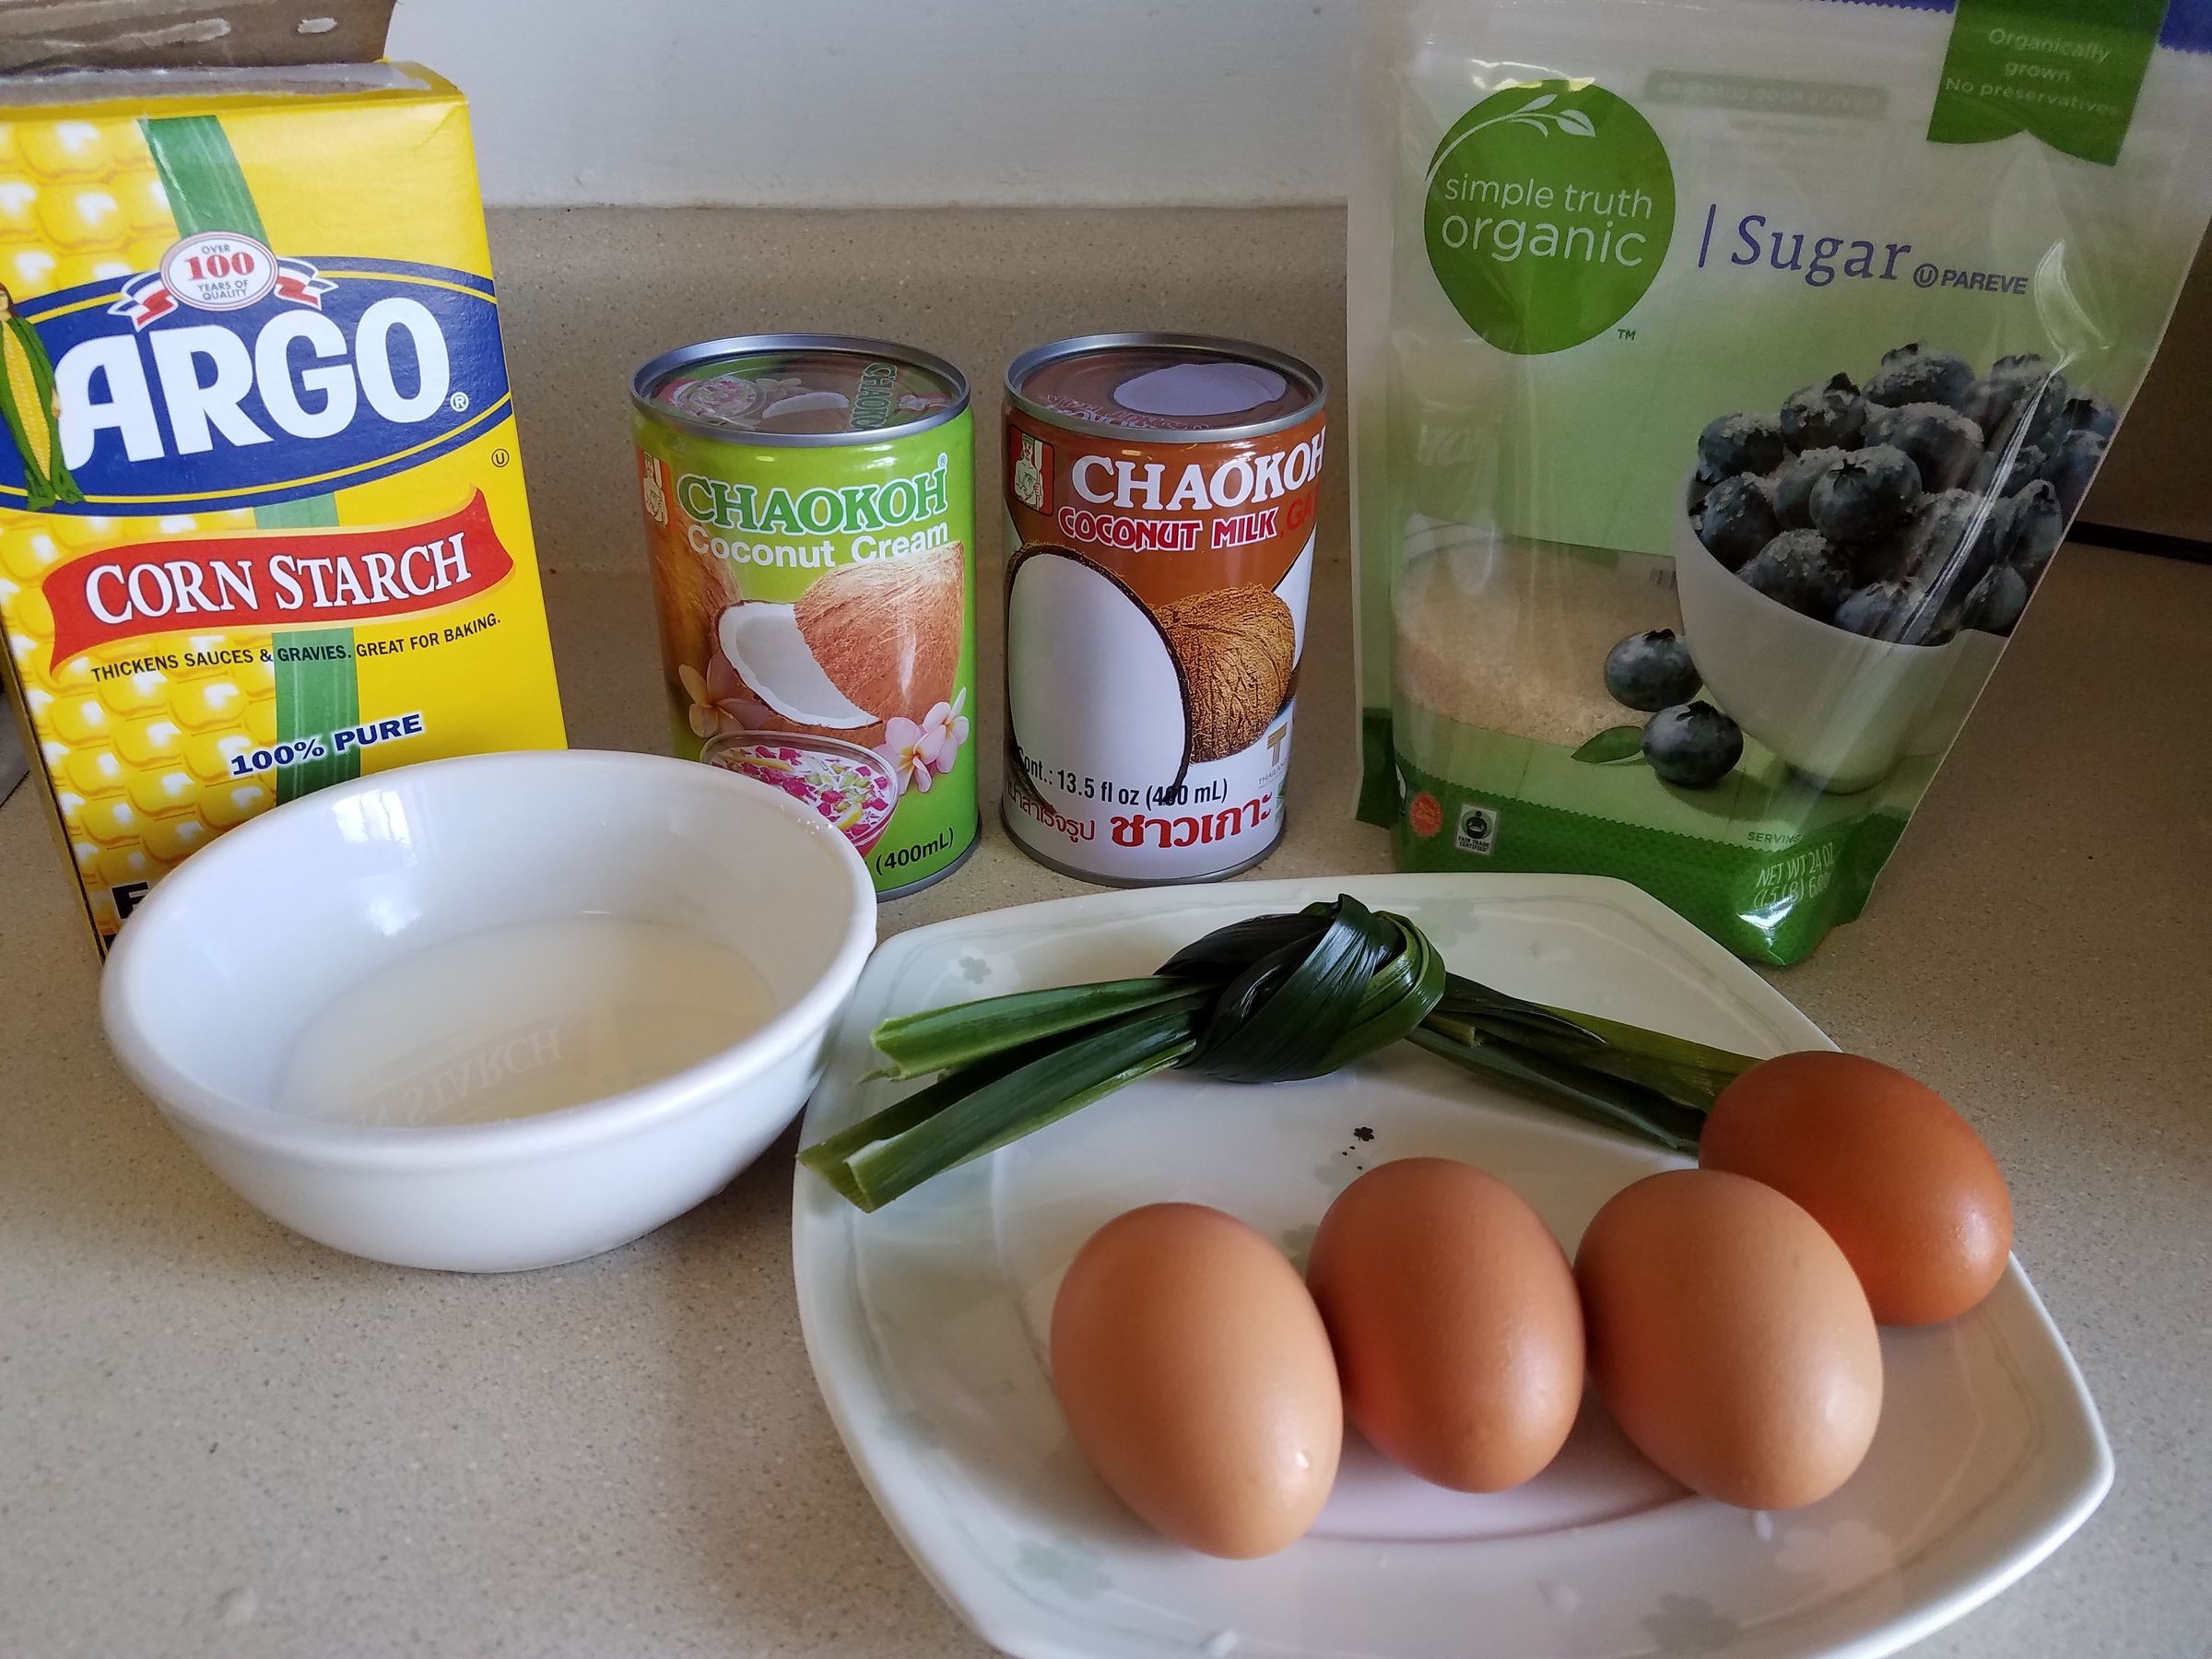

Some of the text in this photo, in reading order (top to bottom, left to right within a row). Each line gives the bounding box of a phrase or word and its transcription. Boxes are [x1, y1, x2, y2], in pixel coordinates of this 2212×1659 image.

[1989, 29, 2110, 65] Organically
[1945, 76, 1974, 92] No
[2005, 61, 2071, 82] grown
[1444, 172, 1653, 219] simple truth
[202, 244, 231, 254] OVER
[1441, 215, 1646, 266] organic
[1731, 215, 1912, 288] Sugar
[184, 252, 254, 280] 100
[197, 279, 249, 292] YEARS OF
[1941, 269, 2028, 295] PAREVE
[203, 288, 248, 301] QUALITY
[850, 362, 898, 430] CHAOKO
[1071, 425, 1327, 511] CHAOKOH
[677, 465, 948, 536] CHAOKOH
[687, 522, 948, 569] Coconut Cream
[1058, 506, 1203, 553] COCONUT
[86, 531, 473, 625] CORN STARCH
[91, 613, 501, 682] THICKENS SAUCES & GRAVIES. GREAT FOR BAKING.
[231, 713, 423, 776] 100% PURE
[1057, 769, 1095, 799] 13.5
[1100, 781, 1112, 803] fl
[1118, 788, 1140, 806] oz
[1194, 778, 1228, 804] mL)
[1109, 792, 1273, 848] ชาวเกาะ
[1458, 836, 1489, 848] FAIR TRADE
[876, 827, 954, 877] (400mL)
[1756, 842, 1834, 888] NET WT 24 OZ
